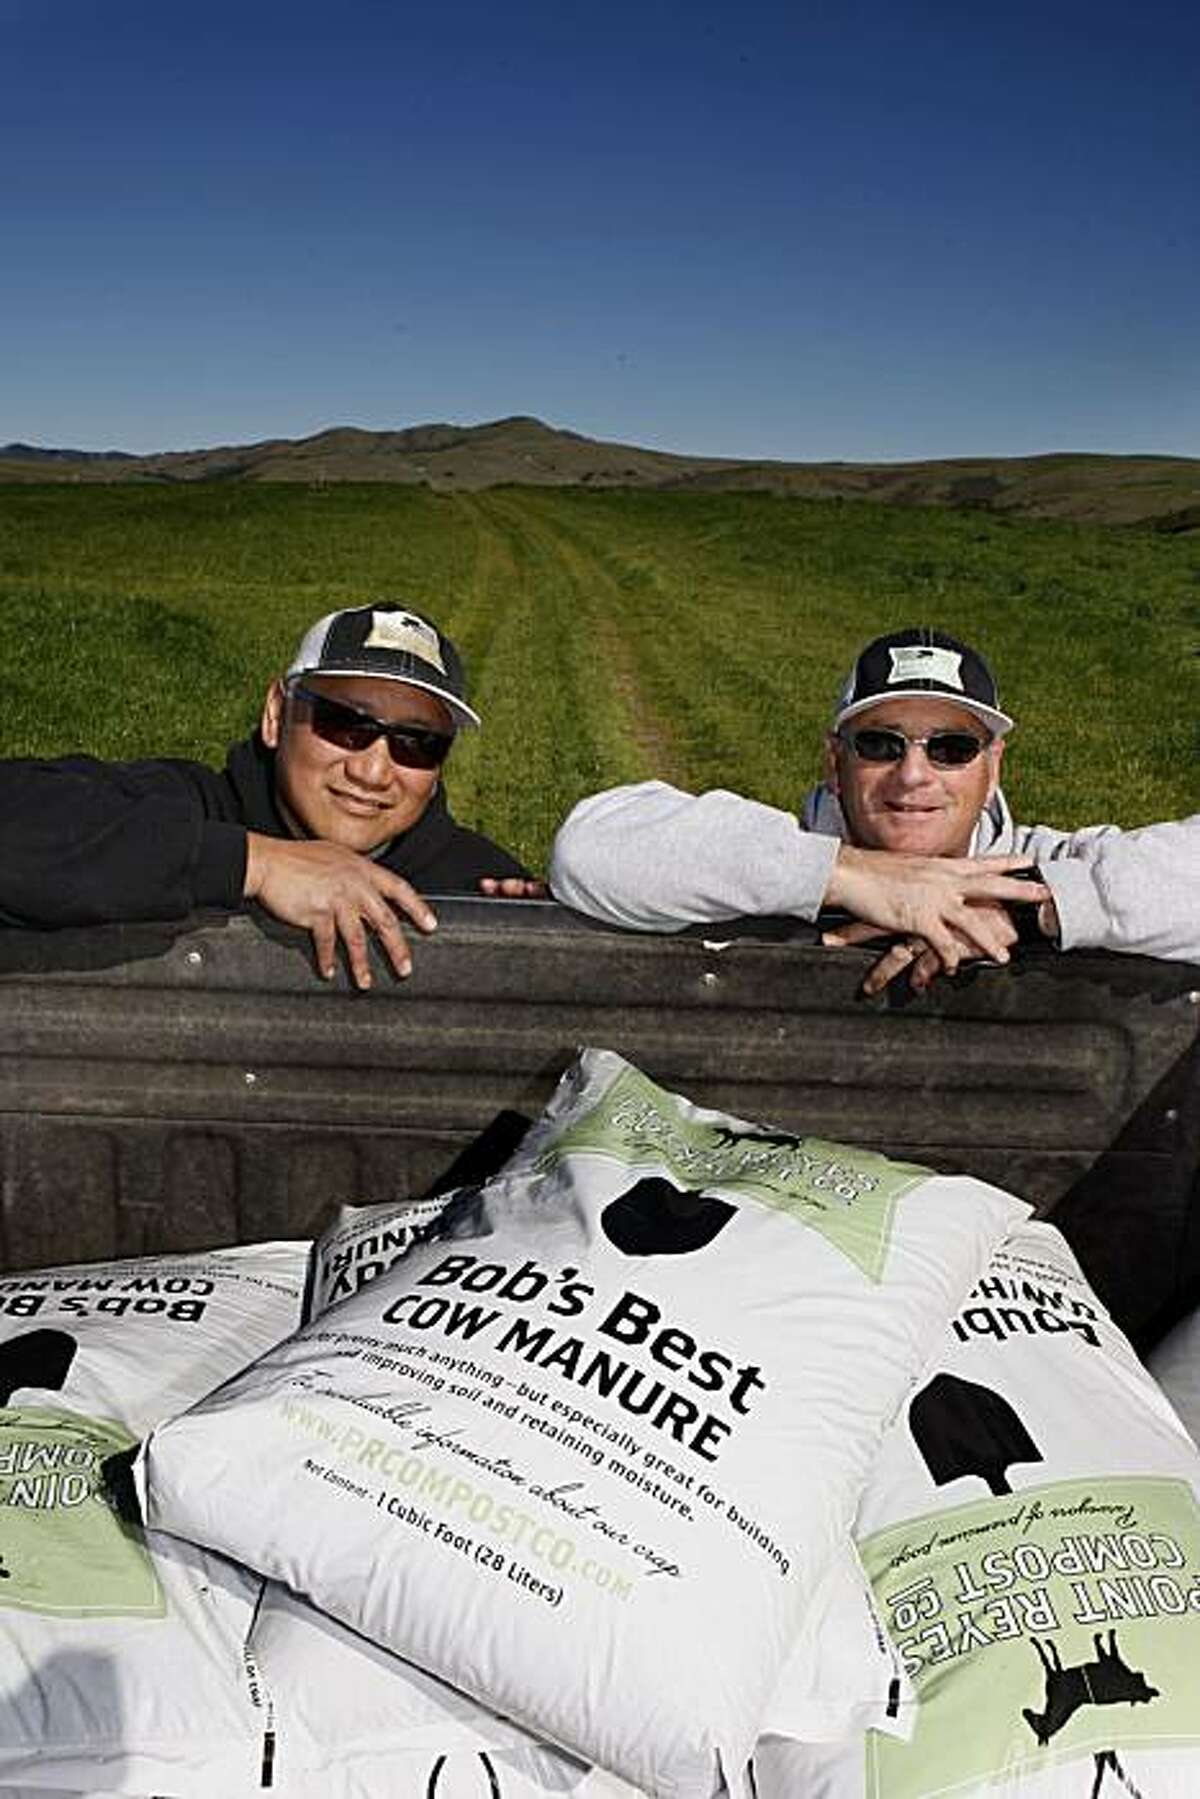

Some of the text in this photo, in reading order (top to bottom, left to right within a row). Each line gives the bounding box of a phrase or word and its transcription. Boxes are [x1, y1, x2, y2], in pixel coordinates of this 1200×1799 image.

[58, 1297, 208, 1322] Bob's
[120, 1277, 216, 1296] COW
[381, 1294, 734, 1464] COW MANURE
[415, 1254, 768, 1416] Bob's Best
[361, 1352, 446, 1391] improving
[448, 1381, 483, 1402] soil
[482, 1396, 521, 1420] and
[518, 1411, 605, 1466] retaining
[608, 1458, 695, 1523] moisture.
[528, 1482, 601, 1520] about
[632, 1543, 682, 1578] crap
[551, 1399, 643, 1457] especially
[643, 1452, 695, 1491] great
[696, 1484, 726, 1510] for
[726, 1505, 791, 1576] building
[387, 1497, 433, 1533] Cubic
[433, 1522, 474, 1556] Foot
[474, 1543, 505, 1572] (28
[507, 1561, 564, 1608] Liters)
[952, 1533, 1186, 1604] COMPOST
[890, 1587, 942, 1633] CO
[898, 1586, 1062, 1678] REYES
